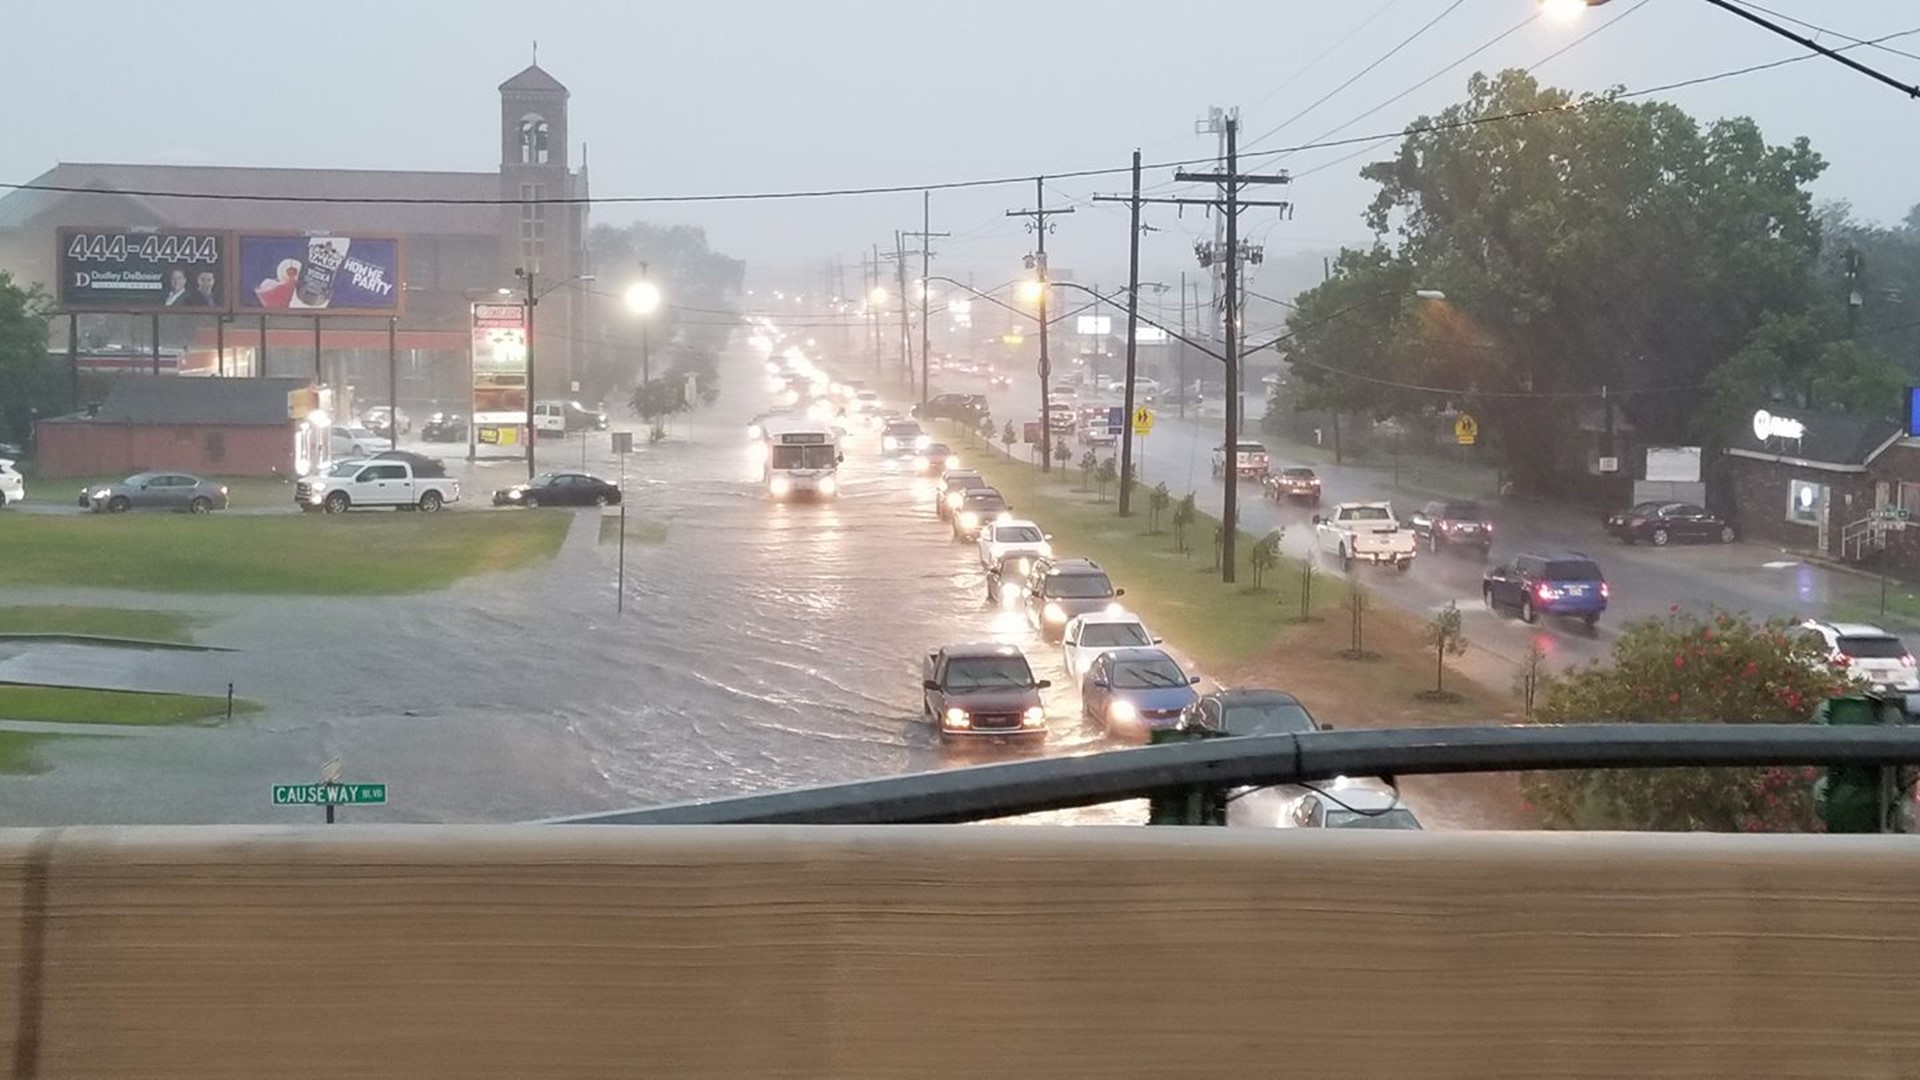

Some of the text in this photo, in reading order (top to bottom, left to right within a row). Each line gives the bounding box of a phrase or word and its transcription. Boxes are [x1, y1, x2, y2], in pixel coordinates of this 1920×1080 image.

[68, 234, 218, 264] 444-4444
[344, 258, 368, 276] HOW
[367, 267, 384, 281] WE
[352, 273, 393, 296] PARTY
[276, 786, 383, 803] CAUSEWAY BLVD
